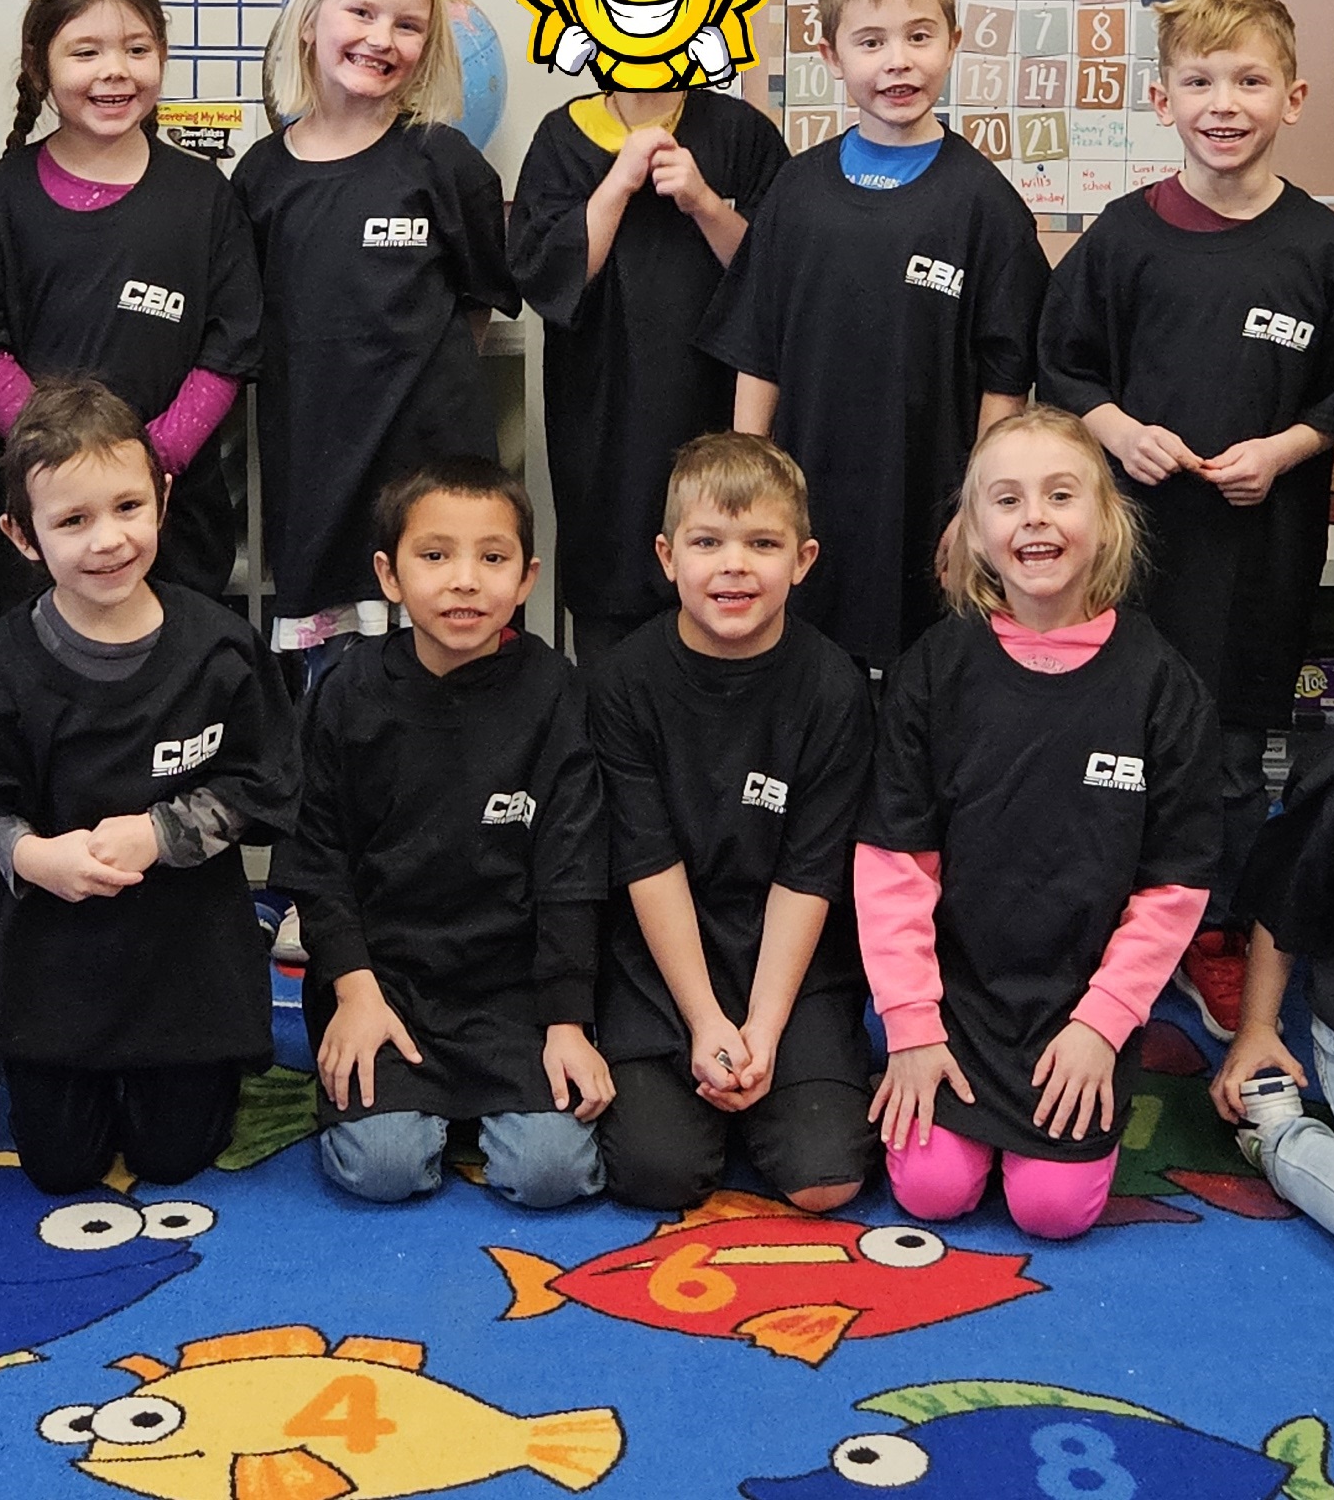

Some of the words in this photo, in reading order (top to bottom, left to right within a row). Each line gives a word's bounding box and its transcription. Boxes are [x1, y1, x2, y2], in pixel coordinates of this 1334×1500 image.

[363, 217, 429, 241] CBO
[120, 280, 185, 314] CBO
[1243, 307, 1315, 346] CBO
[744, 771, 789, 806] CB
[1084, 752, 1145, 788] CB
[642, 1242, 737, 1312] 6
[283, 1375, 397, 1455] 4
[1029, 1422, 1137, 1500] 8
